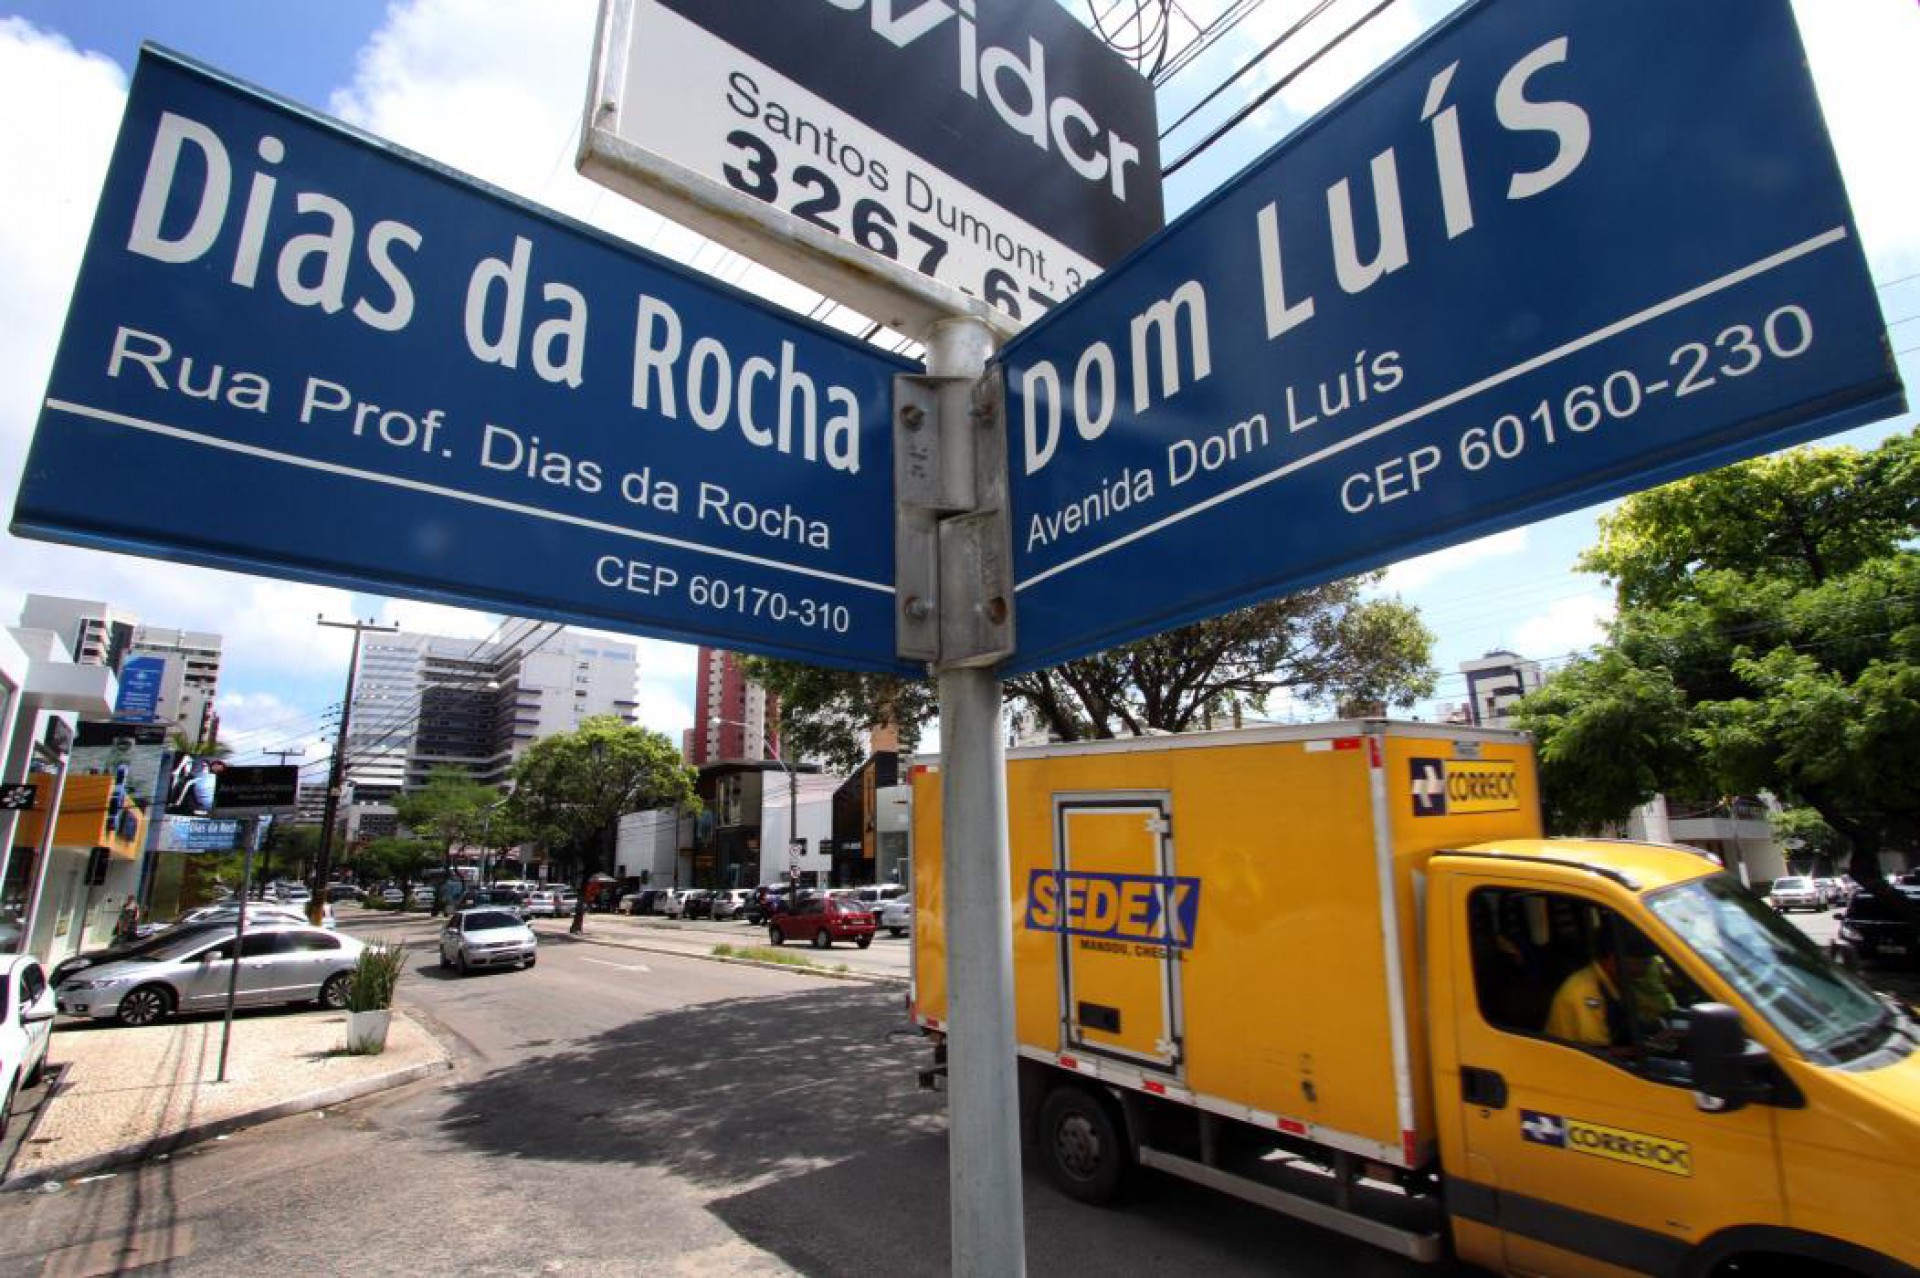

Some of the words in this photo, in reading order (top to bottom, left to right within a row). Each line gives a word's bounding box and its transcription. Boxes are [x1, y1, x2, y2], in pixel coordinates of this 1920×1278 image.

[726, 71, 890, 192] Santos
[905, 171, 1054, 291] Dumont,
[829, 0, 1139, 202] vidcr
[127, 112, 423, 332] Dias
[463, 234, 588, 390] da
[631, 293, 860, 474] Rocha
[1022, 280, 1212, 476] Dom
[1256, 35, 1592, 341] Luís
[107, 326, 270, 414] Rua
[300, 377, 452, 458] Prof.
[480, 424, 602, 494] Dias
[621, 466, 679, 513] da
[698, 481, 829, 550] Rocha
[1027, 468, 1155, 552] Avenida
[1168, 413, 1269, 487] Dom
[1285, 349, 1404, 437] Luís
[1340, 445, 1442, 514] CEP
[1459, 304, 1813, 470] 60160-230
[596, 555, 679, 596] CEP
[689, 575, 849, 633] 60170-310
[1030, 873, 1193, 942] SEDEX
